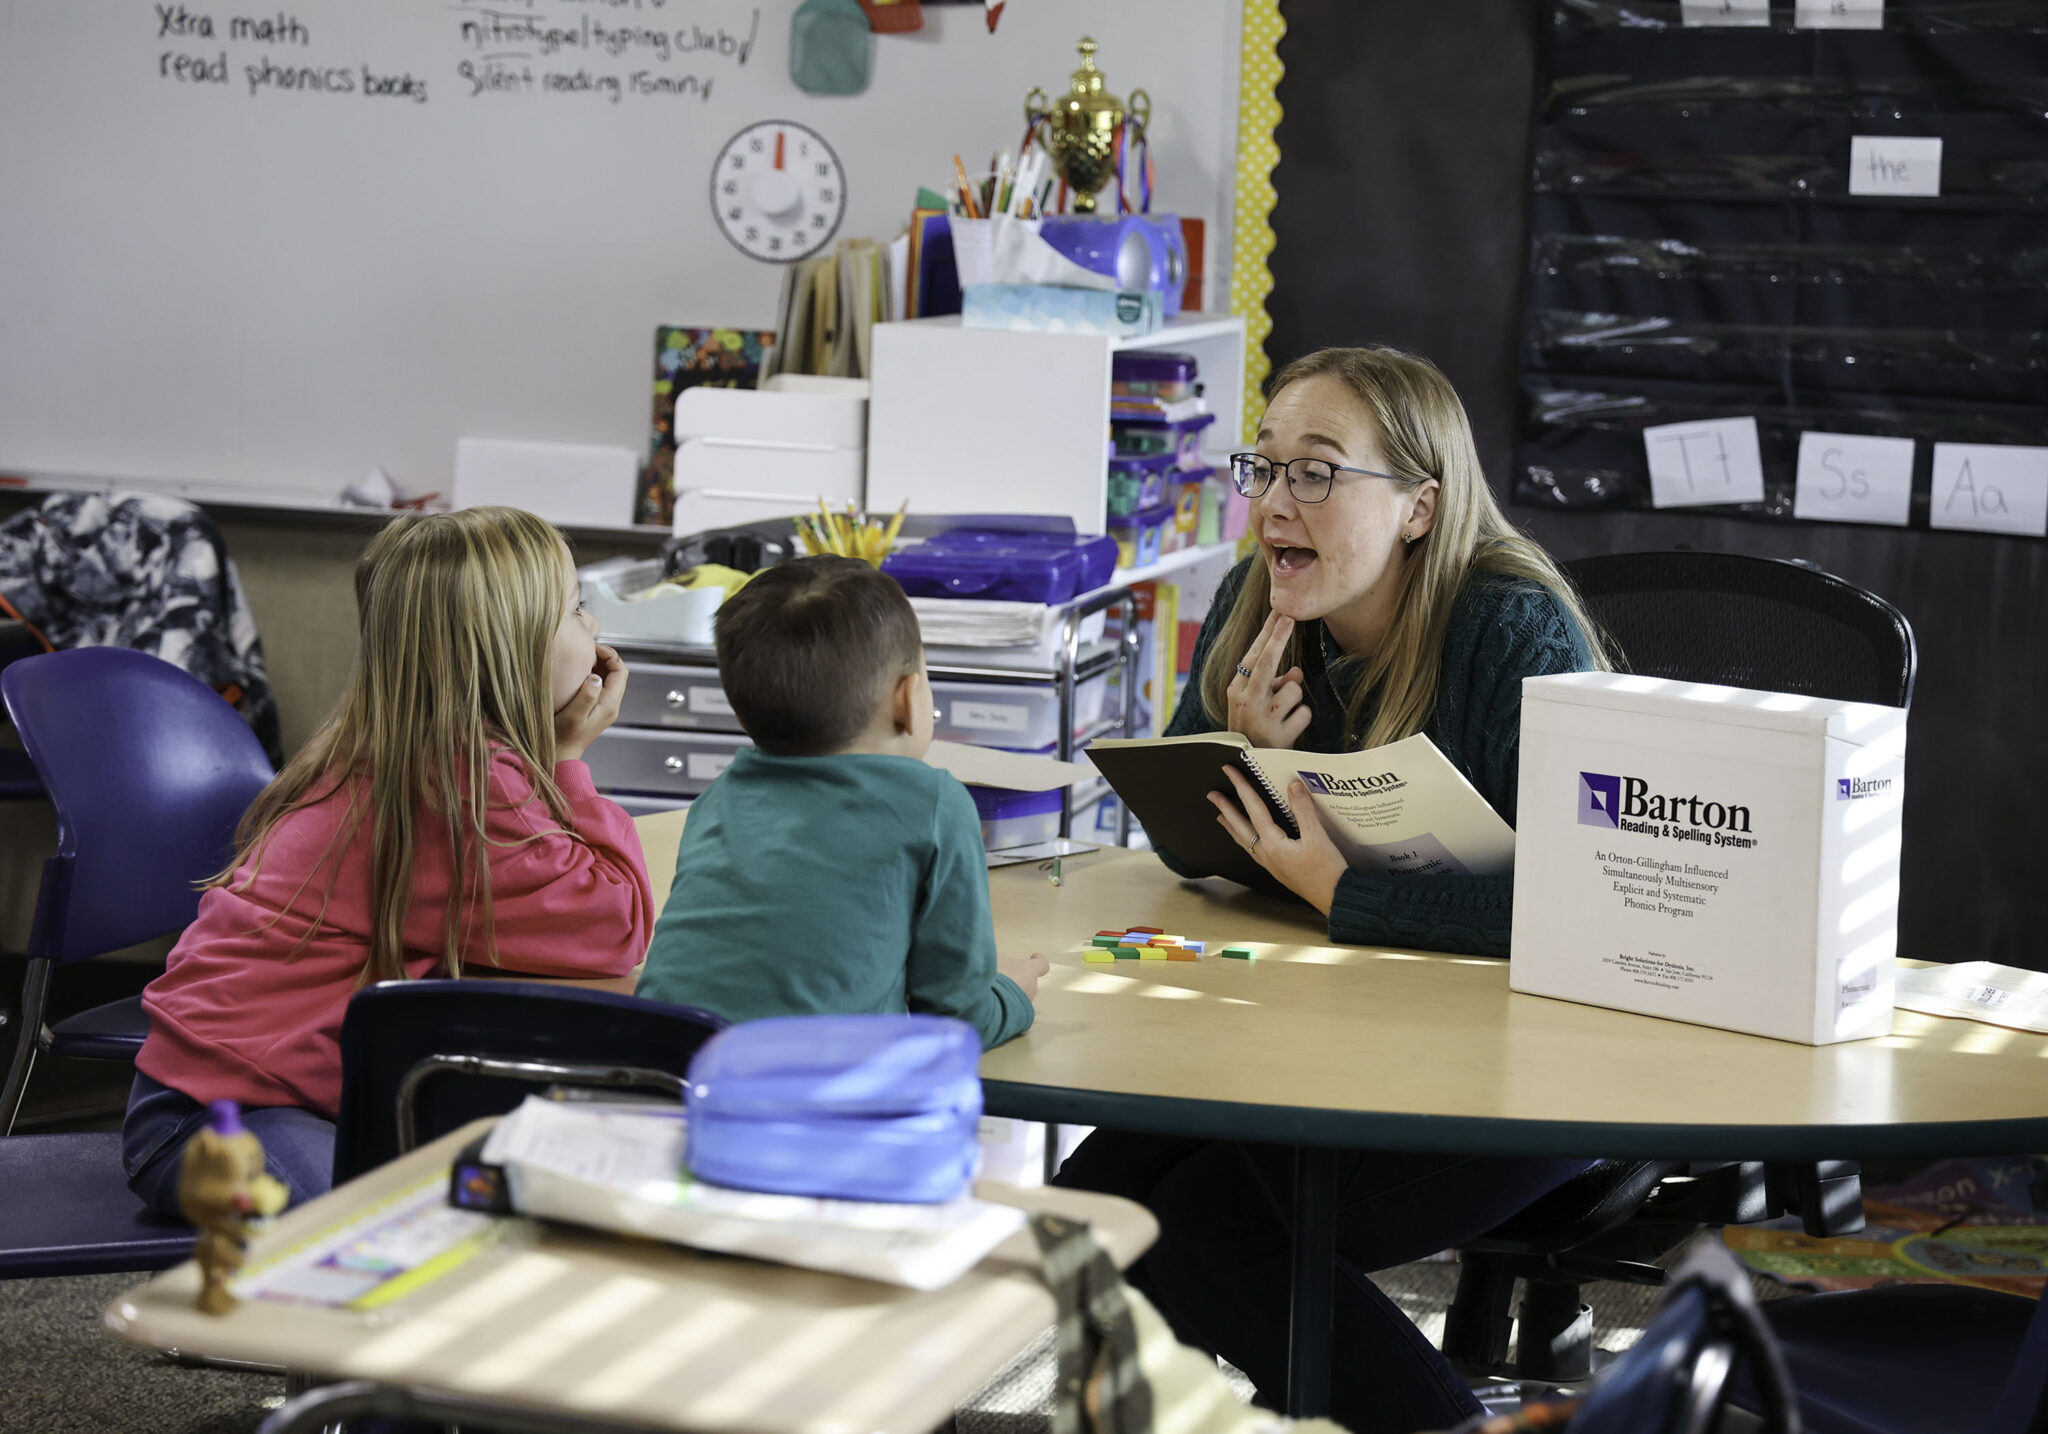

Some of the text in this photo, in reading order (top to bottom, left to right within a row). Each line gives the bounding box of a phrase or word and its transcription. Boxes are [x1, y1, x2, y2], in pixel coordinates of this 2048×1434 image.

[154, 3, 309, 45] Xtra math
[675, 25, 738, 55] club
[160, 51, 428, 103] read phonics books
[542, 67, 621, 104] reading
[1865, 147, 1911, 183] the
[1819, 447, 1871, 500] Ss
[1944, 457, 2010, 518] Aa
[1319, 771, 1402, 791] Barton
[1331, 790, 1354, 798] Reading
[1359, 786, 1384, 798] Spelling
[1852, 777, 1892, 793] Barton
[1621, 776, 1753, 833] Barton
[1621, 818, 1660, 838] Reading
[1661, 824, 1670, 837] &
[1672, 826, 1711, 846] Spelling
[1388, 859, 1443, 876] Phonemic
[1389, 850, 1418, 861] Book 1
[1595, 850, 1729, 880] An Orton-Gillingham Influenced
[1602, 865, 1719, 895] Simultaneously Multisensory
[1613, 881, 1707, 906] Explicit and Systematic
[1624, 897, 1694, 918] Phonics Program
[1619, 954, 1634, 962] Bright
[1634, 956, 1656, 966] Solutions
